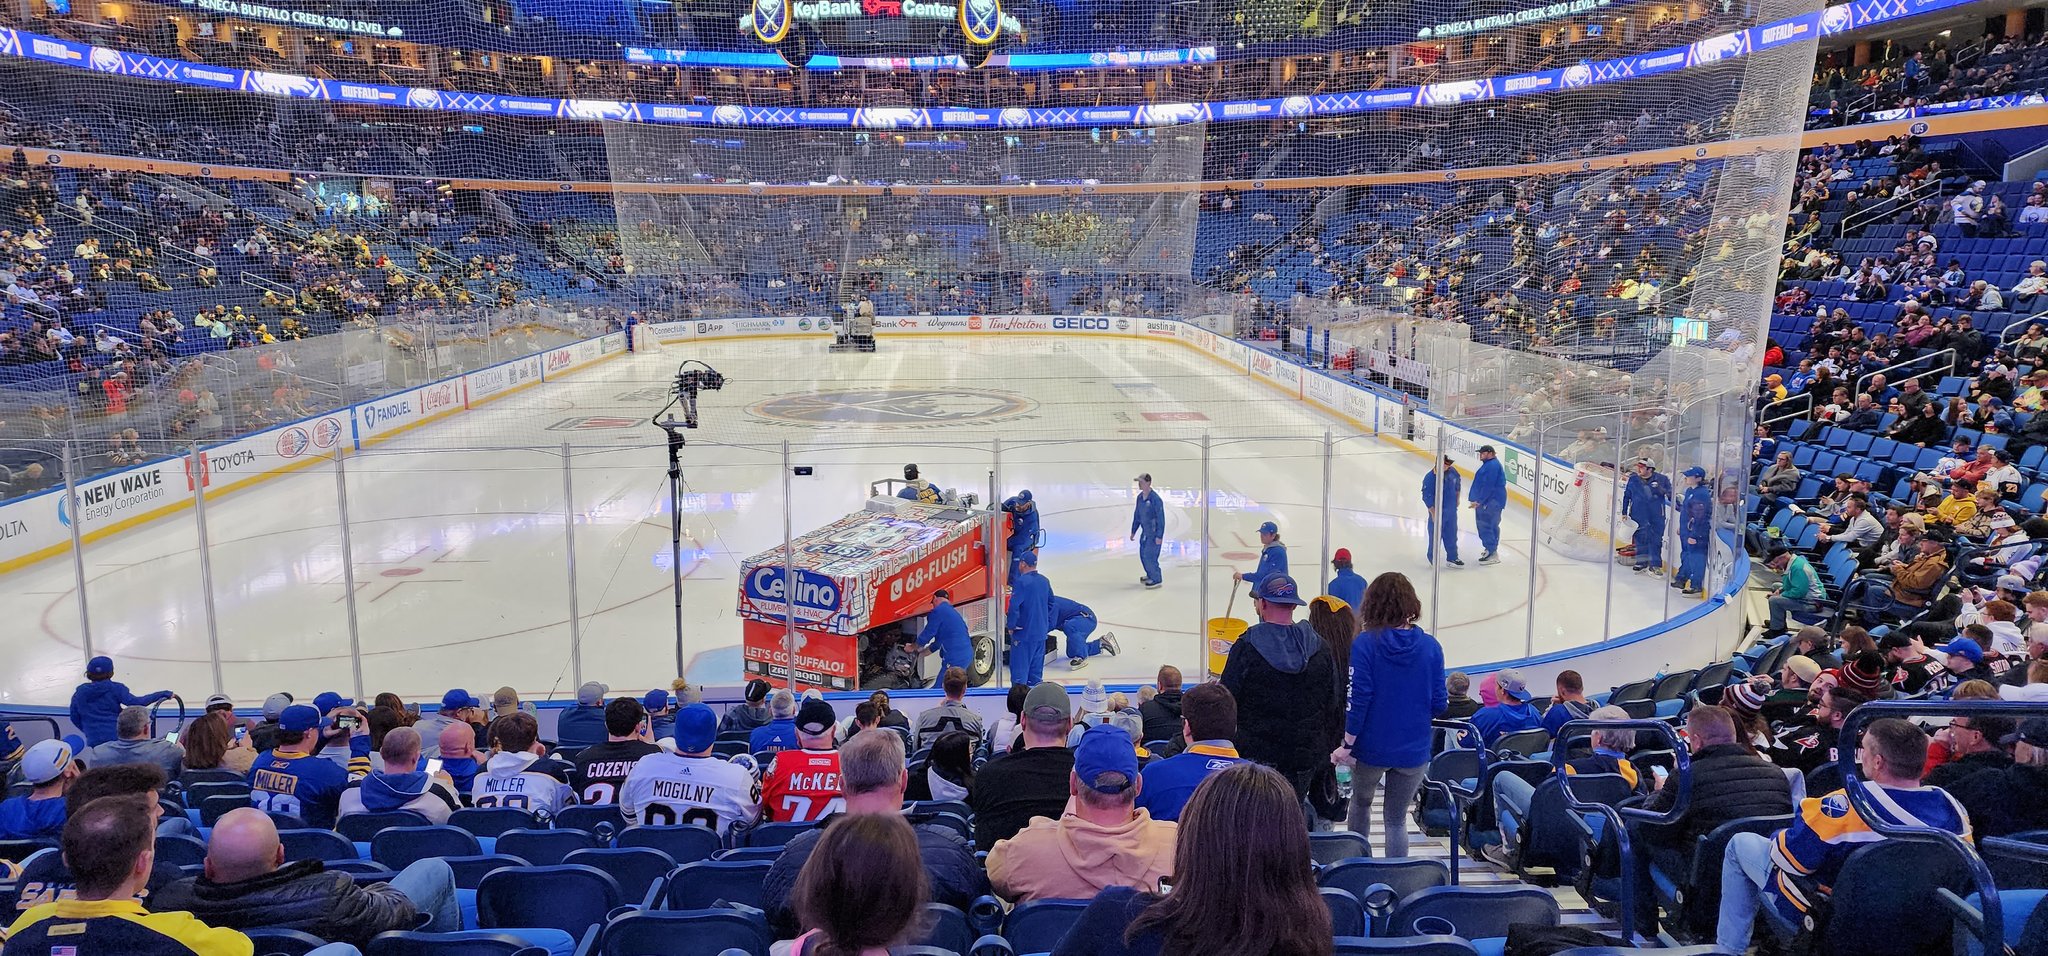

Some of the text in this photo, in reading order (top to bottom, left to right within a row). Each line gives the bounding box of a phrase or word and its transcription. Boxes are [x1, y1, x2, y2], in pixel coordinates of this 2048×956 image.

[241, 4, 290, 21] BUFFALO
[292, 11, 326, 26] CREEK
[326, 15, 348, 30] 300
[351, 20, 385, 35] LEVEL
[793, 1, 956, 19] KeyBank Center
[1435, 0, 1596, 36] SENECA BUFFALO CREEK 300 LEVEL
[927, 317, 967, 330] Wegmans
[988, 317, 1047, 330] Tim Hortons
[1052, 317, 1109, 330] GEICO
[377, 401, 412, 422] FANDUEL
[211, 449, 256, 473] TOYOTA
[83, 469, 163, 507] NEW WAVE
[86, 486, 164, 521] Energy Corporation
[905, 543, 968, 593] 68-FLUSH
[803, 610, 824, 619] HVAC
[745, 645, 845, 673] LET'S GO BUFFALO!
[255, 771, 293, 794] MILLER
[485, 777, 525, 793] MILLER
[653, 780, 715, 804] MOGILNY
